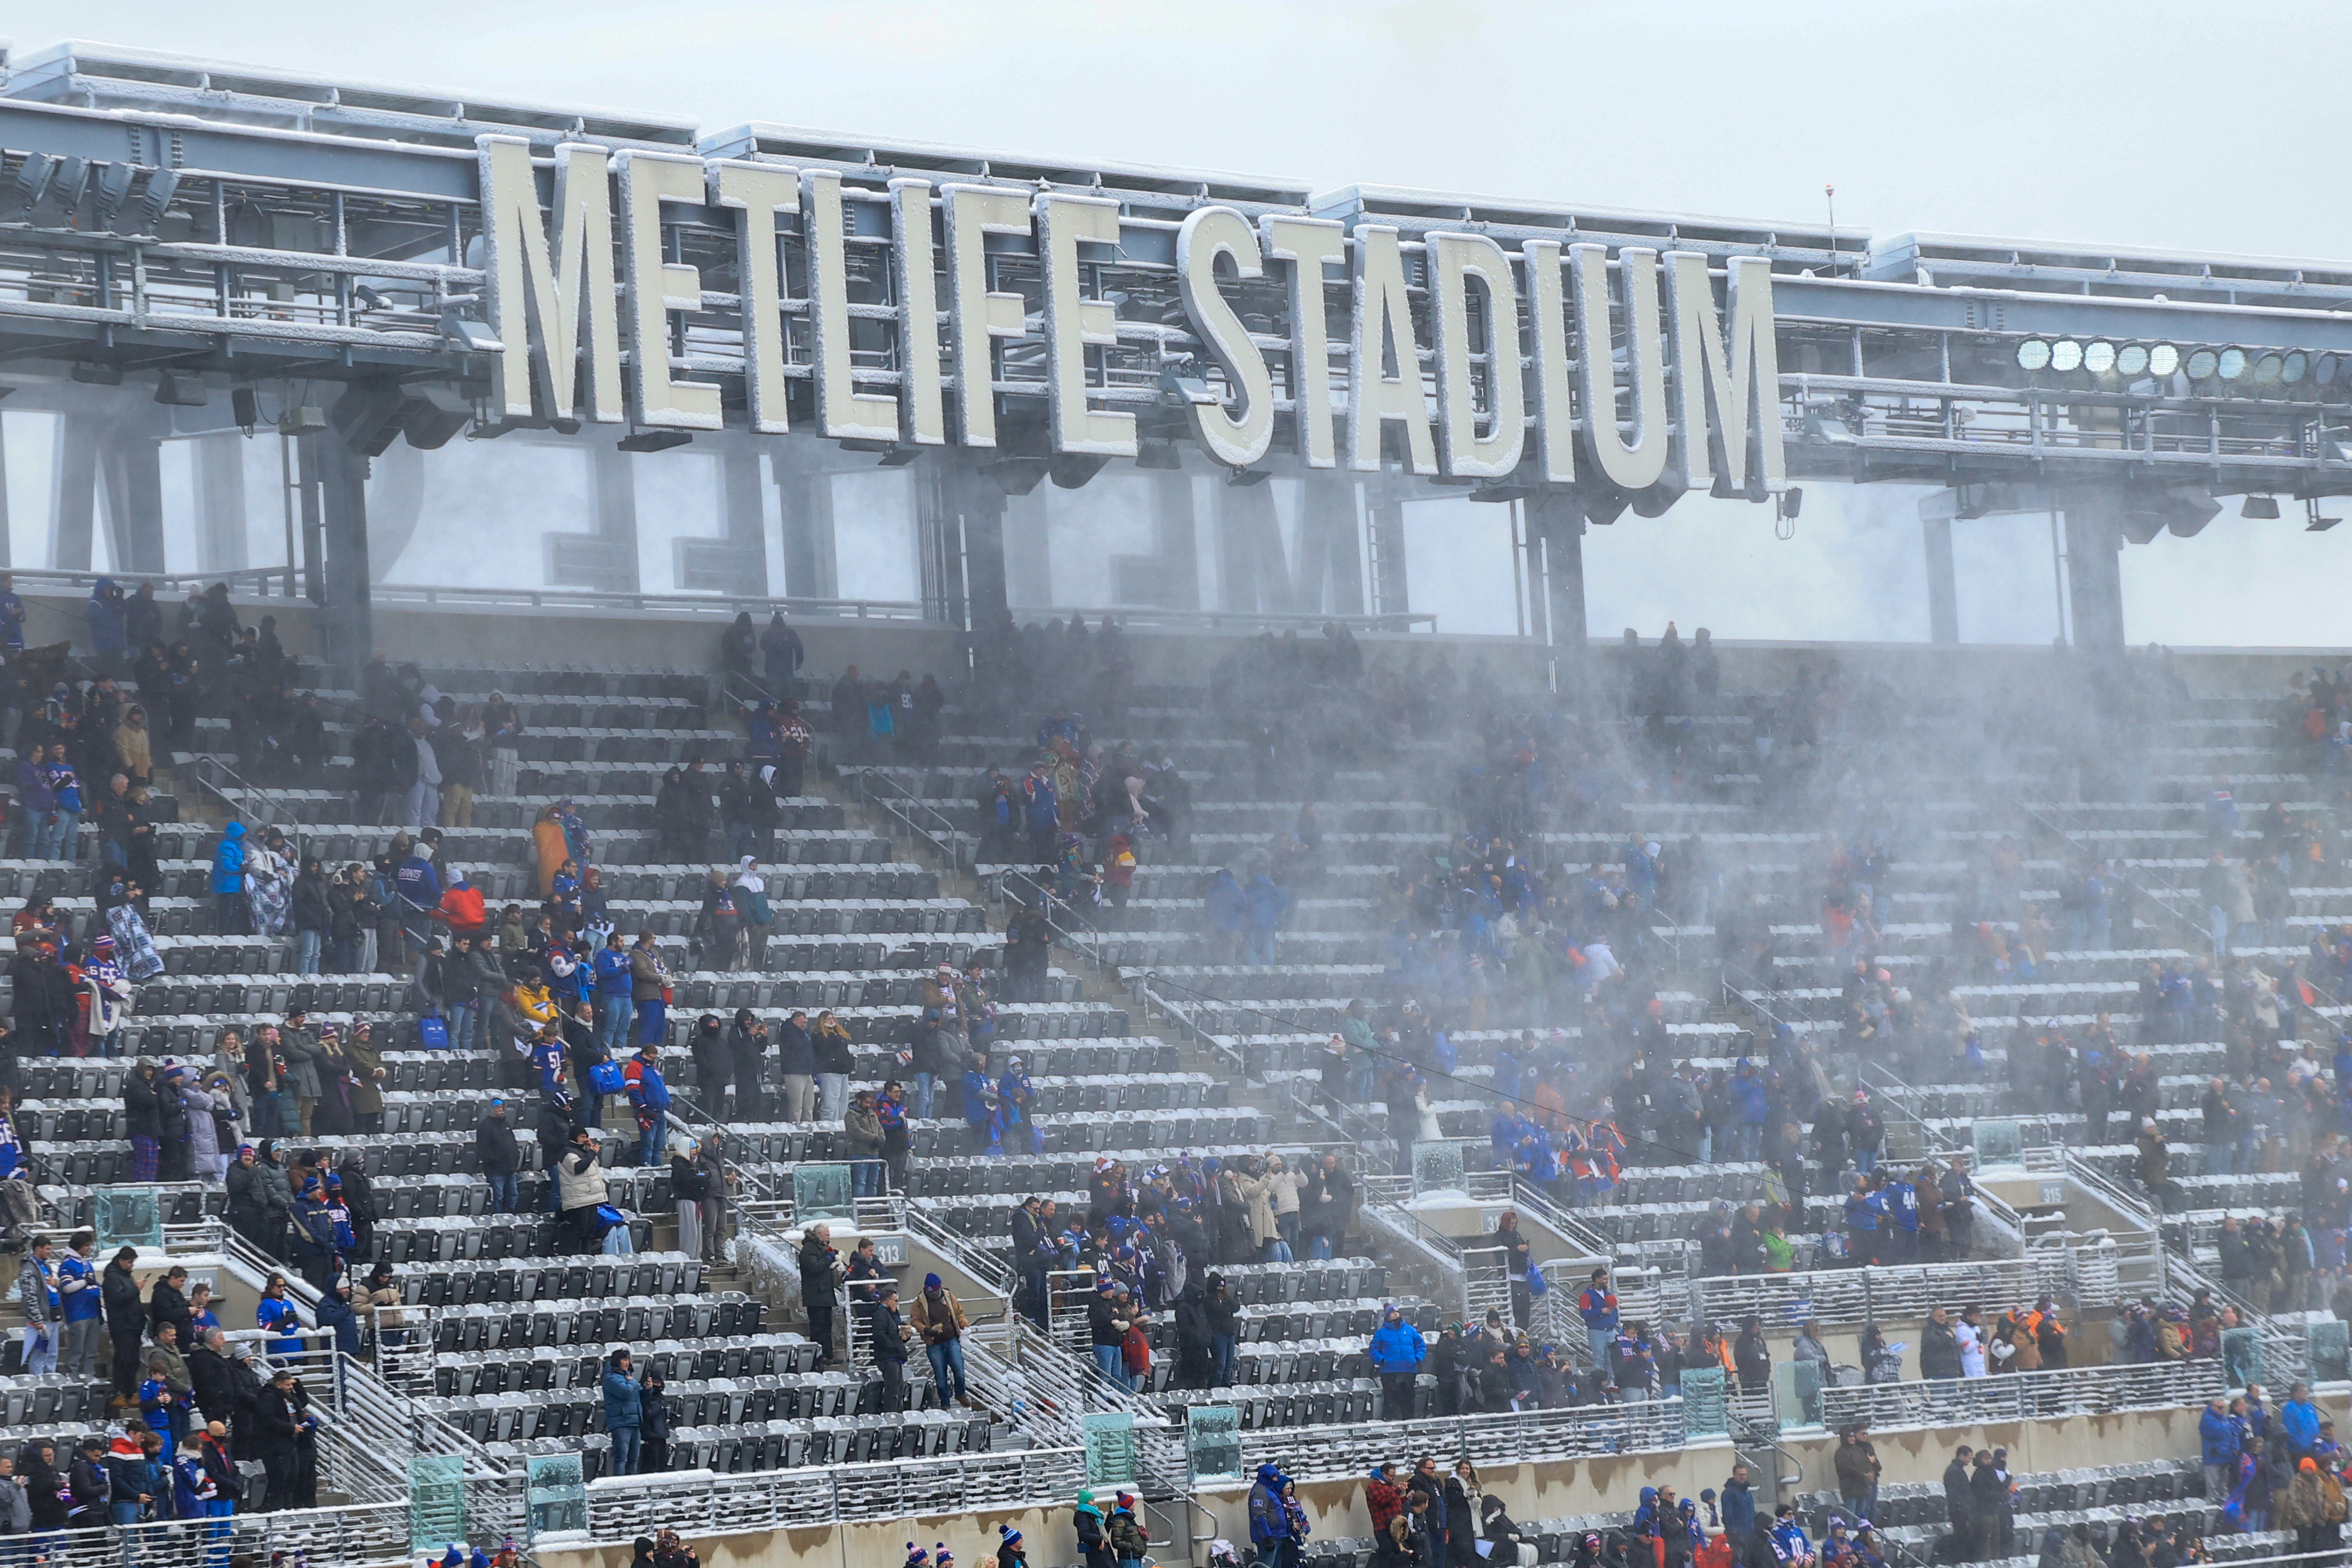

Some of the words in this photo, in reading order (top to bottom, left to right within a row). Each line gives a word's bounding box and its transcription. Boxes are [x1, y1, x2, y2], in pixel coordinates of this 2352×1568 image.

[476, 134, 1138, 457] METLIFE
[1177, 205, 1787, 494] STADIUM
[398, 868, 422, 879] GIANTS
[547, 1052, 562, 1069] 51
[2044, 1187, 2062, 1203] 315
[1487, 1216, 1500, 1232] 31
[878, 1244, 900, 1263] 313
[1788, 1537, 1805, 1557] 10
